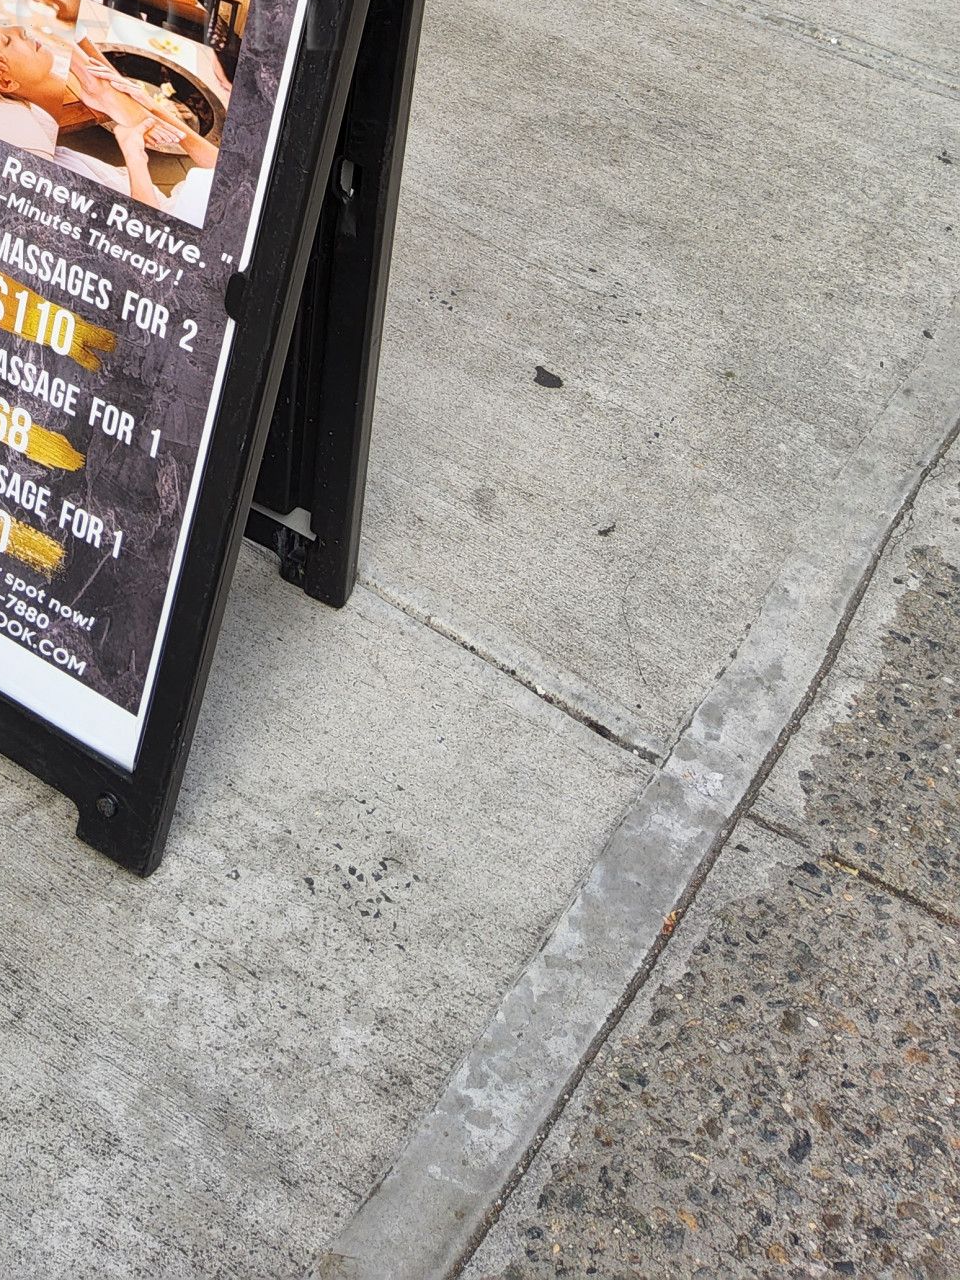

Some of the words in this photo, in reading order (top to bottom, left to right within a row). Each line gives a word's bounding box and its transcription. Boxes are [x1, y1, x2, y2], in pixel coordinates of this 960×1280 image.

[1, 156, 98, 220] Renew.
[106, 203, 207, 269] Revive.
[89, 228, 171, 283] Therapy
[121, 290, 170, 341] FOR
[179, 318, 199, 354] 2
[88, 396, 135, 447] FOR
[149, 428, 162, 460] 1
[59, 499, 104, 549] FOR
[112, 530, 124, 560] 1
[4, 570, 45, 605] spot
[48, 595, 96, 632] now!
